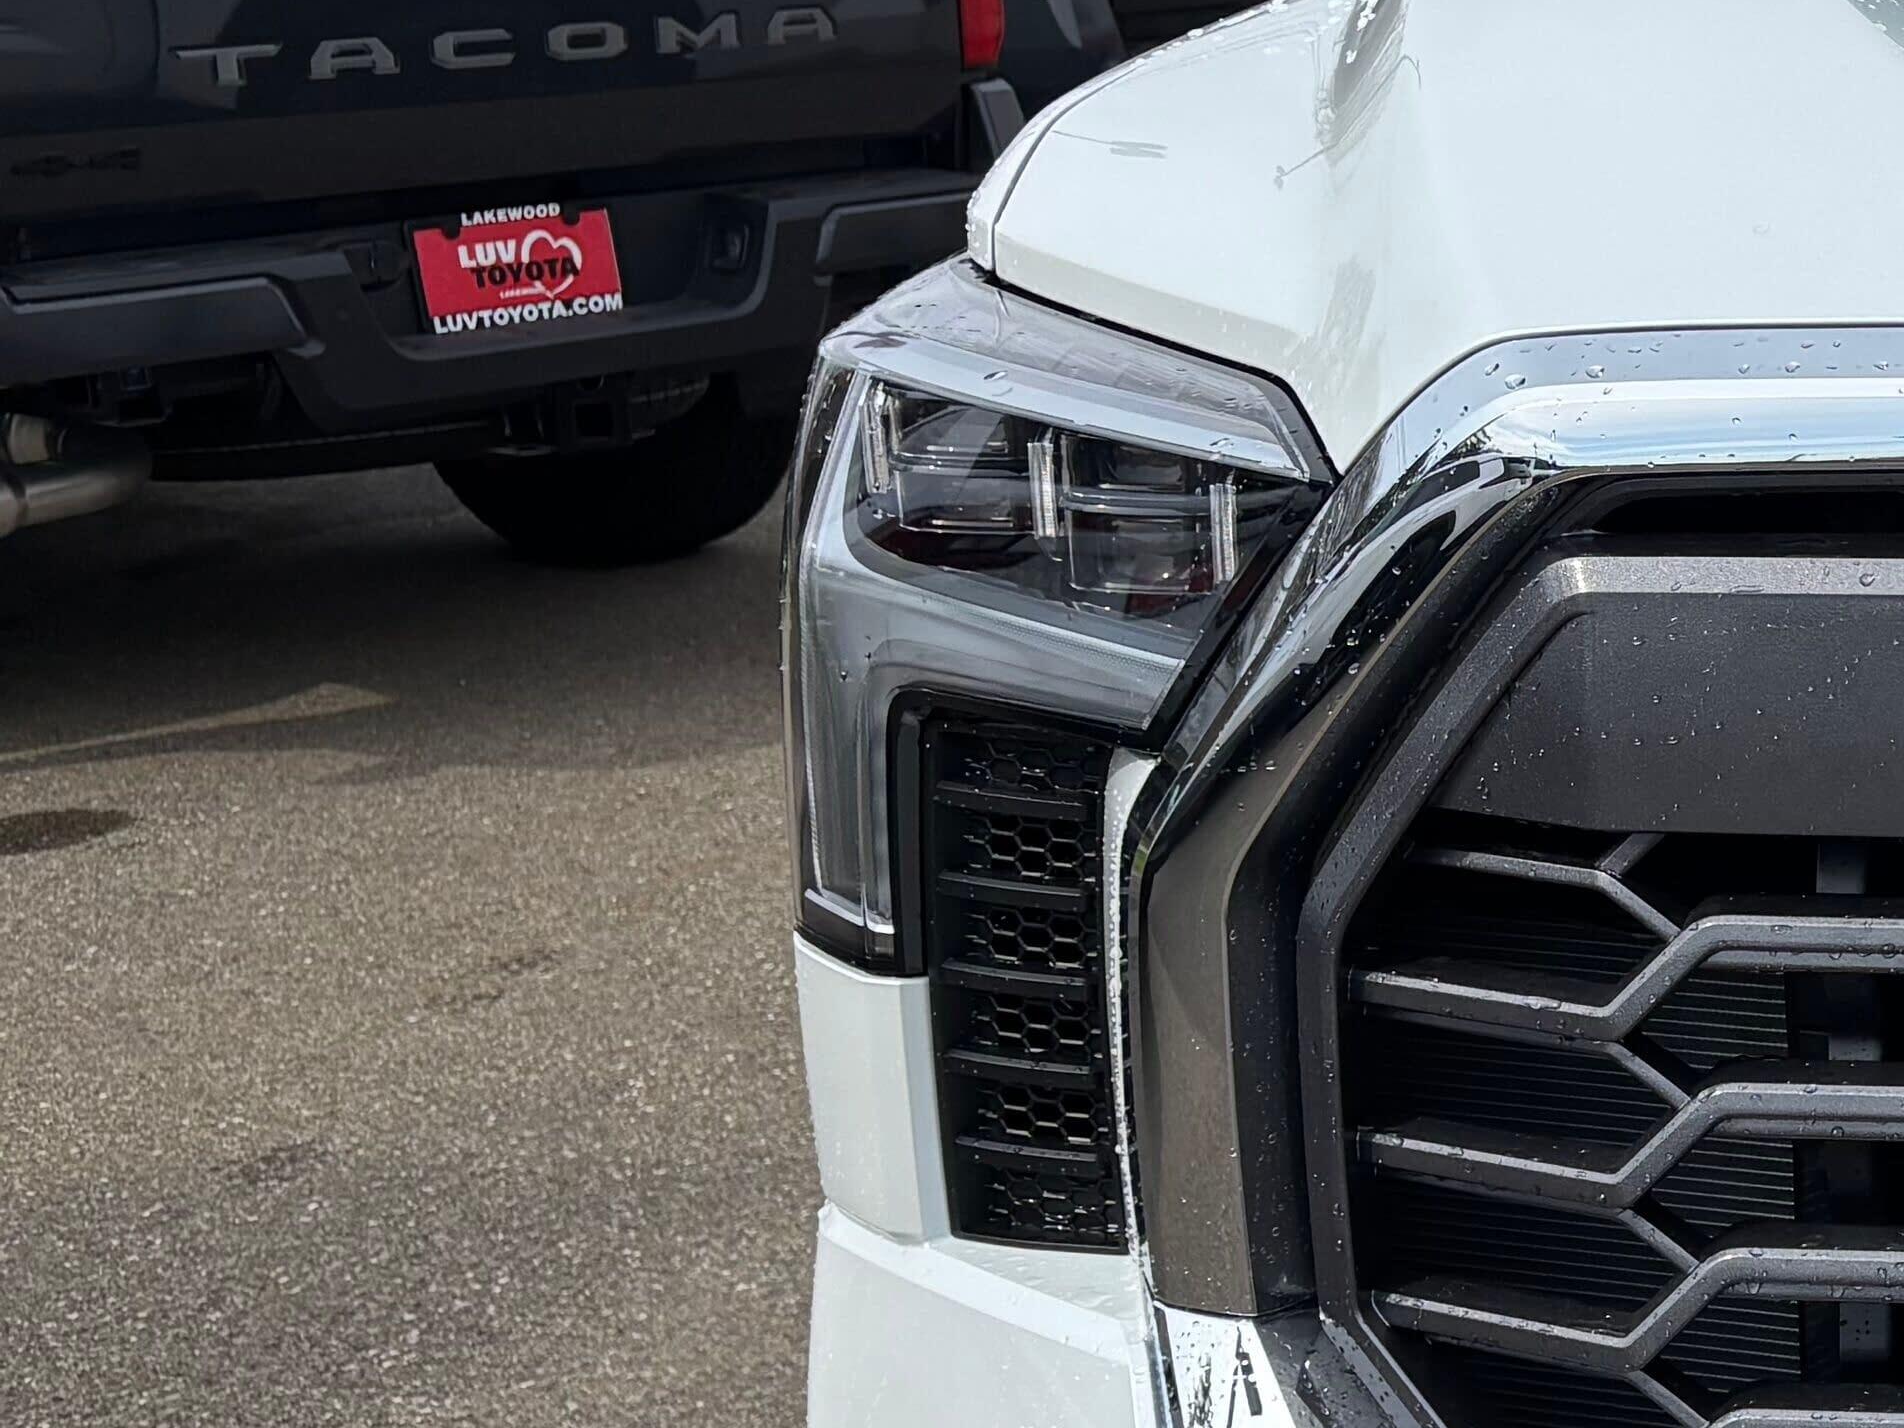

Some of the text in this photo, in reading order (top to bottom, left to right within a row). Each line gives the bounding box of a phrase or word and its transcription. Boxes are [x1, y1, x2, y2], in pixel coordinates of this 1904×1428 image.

[172, 5, 838, 87] TACOMA
[460, 202, 561, 228] LAKEWOOD
[457, 238, 517, 269] LUV
[470, 254, 581, 289] TOYOTA
[433, 292, 624, 335] LUVTOYOTA.COM
